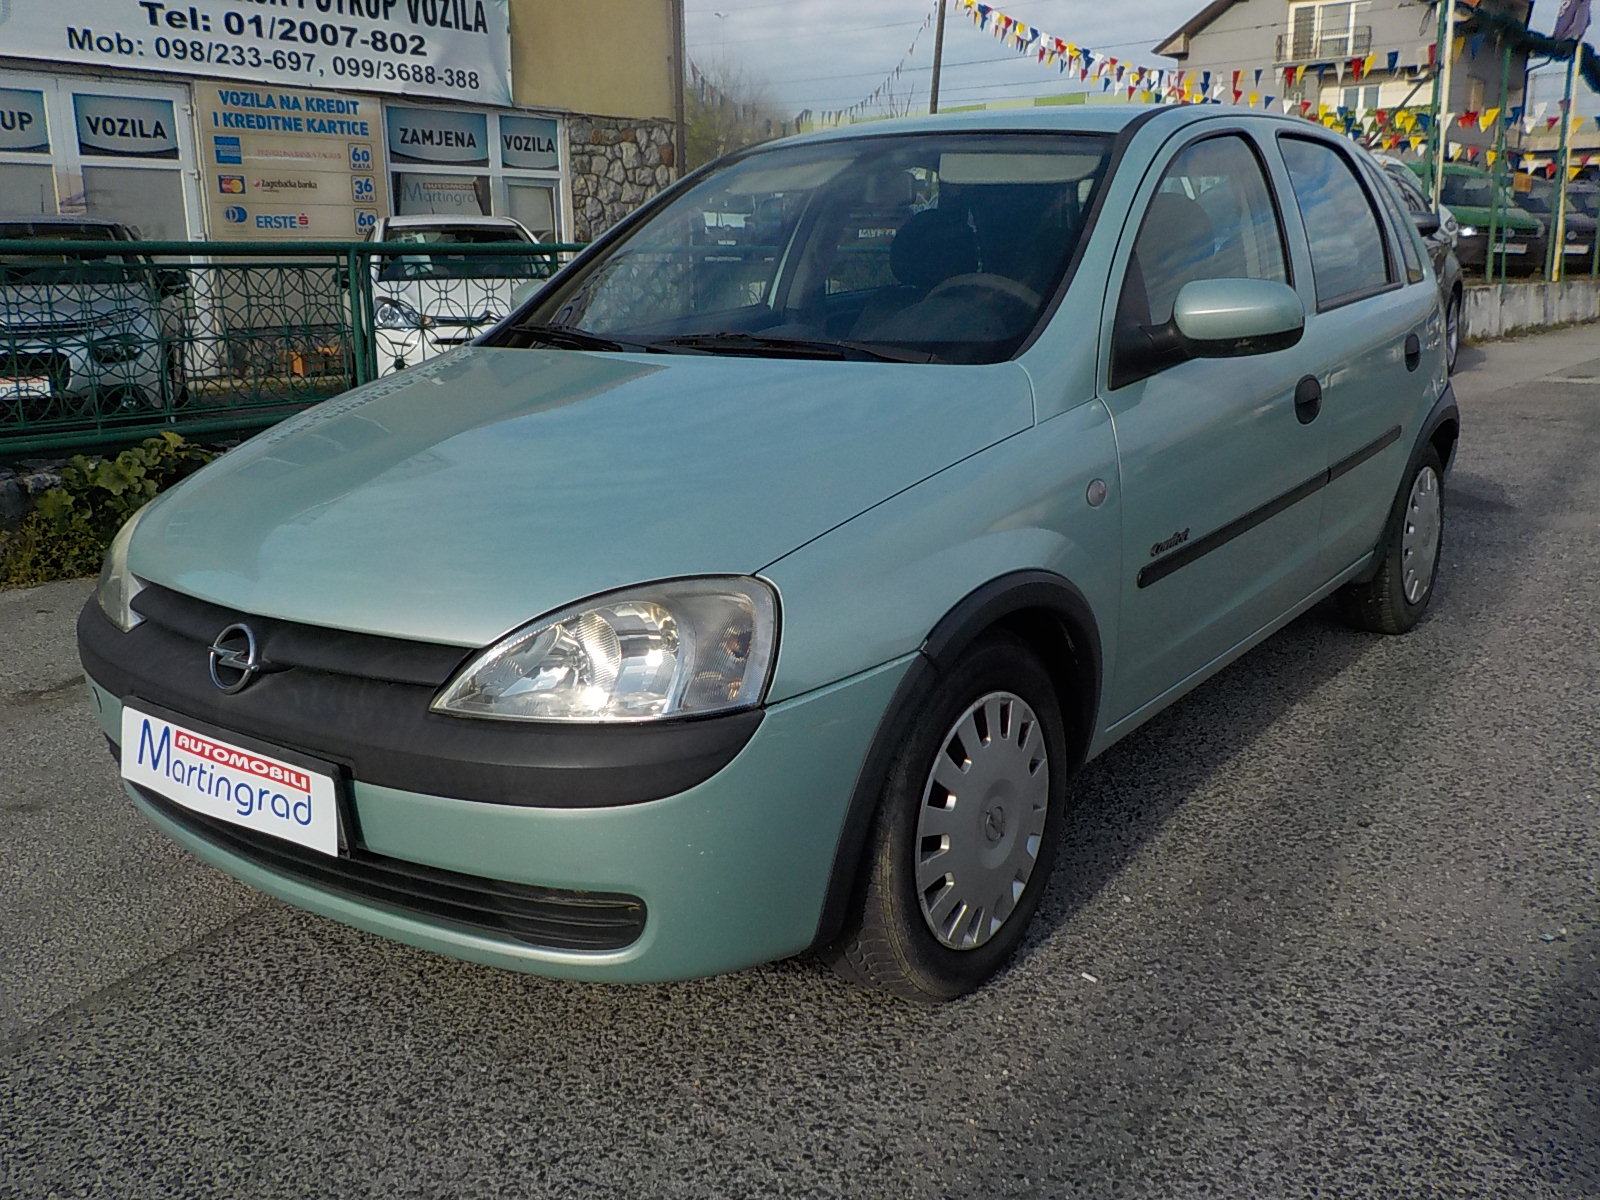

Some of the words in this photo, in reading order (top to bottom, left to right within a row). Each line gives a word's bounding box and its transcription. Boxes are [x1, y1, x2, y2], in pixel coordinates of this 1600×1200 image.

[139, 1, 210, 32] Tel:
[224, 11, 427, 57] 01/2007-802
[406, 0, 489, 34] VOZILA
[67, 26, 144, 56] Mob:
[154, 36, 325, 77] 098/233-697,
[333, 55, 480, 90] 099/3688-388
[218, 89, 276, 109] VOZILA
[279, 95, 302, 111] NA
[305, 97, 359, 115] KREDIT
[86, 115, 168, 140] VOZILA
[213, 112, 219, 127] I
[223, 112, 303, 131] KREDITNE
[306, 118, 369, 136] KARTICE
[400, 127, 477, 148] ZAMJENA
[503, 134, 556, 153] VOZILA
[351, 148, 370, 162] 60
[355, 178, 373, 194] 36
[256, 215, 297, 229] ERSTE
[357, 212, 376, 226] 60
[137, 718, 312, 826] Martingrad
[177, 734, 307, 790] AUTOMOBILI
